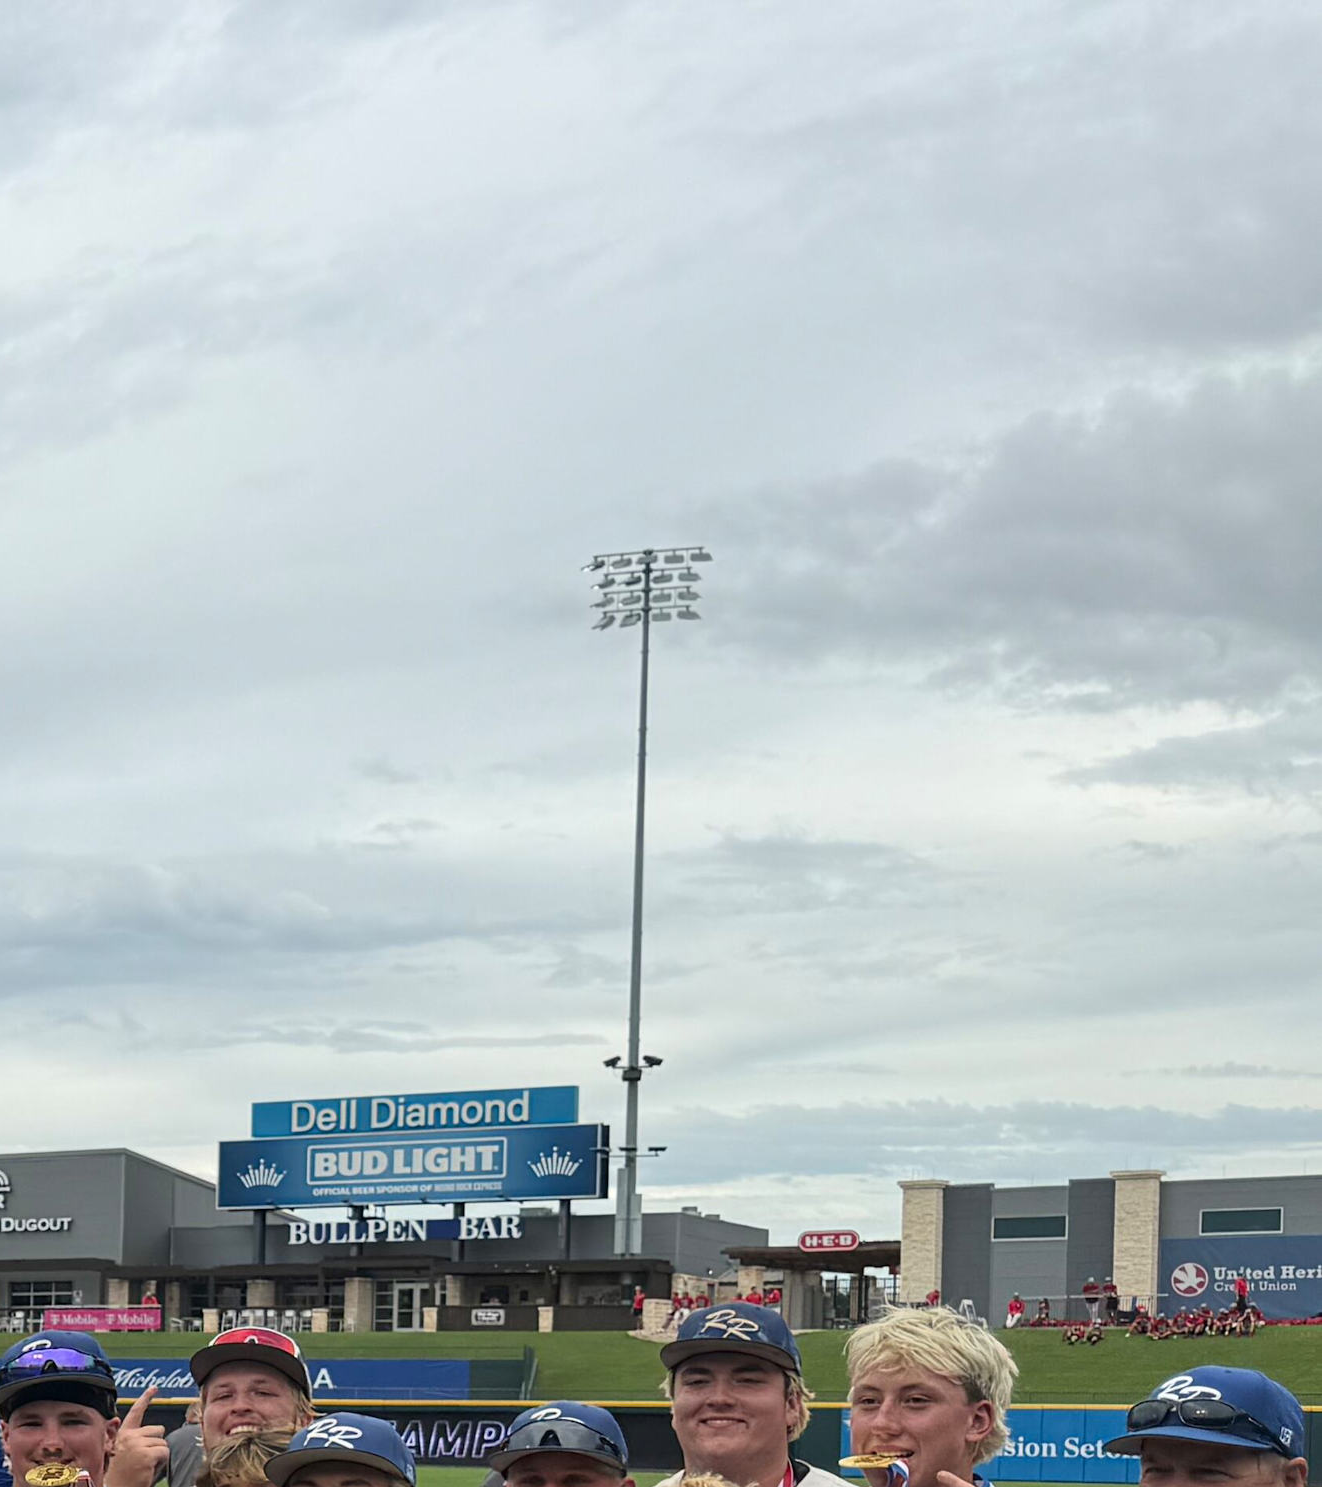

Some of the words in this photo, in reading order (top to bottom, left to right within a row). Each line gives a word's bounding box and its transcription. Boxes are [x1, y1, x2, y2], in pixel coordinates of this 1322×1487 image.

[291, 1099, 357, 1134] Dell
[371, 1090, 530, 1130] Diamond
[313, 1150, 388, 1178] BUD
[393, 1145, 499, 1174] LIGHT
[313, 1187, 350, 1197] OFFICIAL
[352, 1186, 375, 1195] BEER
[376, 1185, 419, 1194] SPONSOR
[420, 1184, 433, 1192] OF
[1, 1217, 73, 1232] DUGOUT
[287, 1218, 428, 1245] BULLPEN
[458, 1215, 523, 1241] BAR
[1214, 1266, 1276, 1280] Unted
[1281, 1266, 1322, 1279] Heri
[1259, 1281, 1297, 1292] Union
[62, 1313, 98, 1325] Mobile
[118, 1313, 155, 1325] Mobile
[701, 1309, 759, 1341] RR
[304, 1418, 363, 1449] RR
